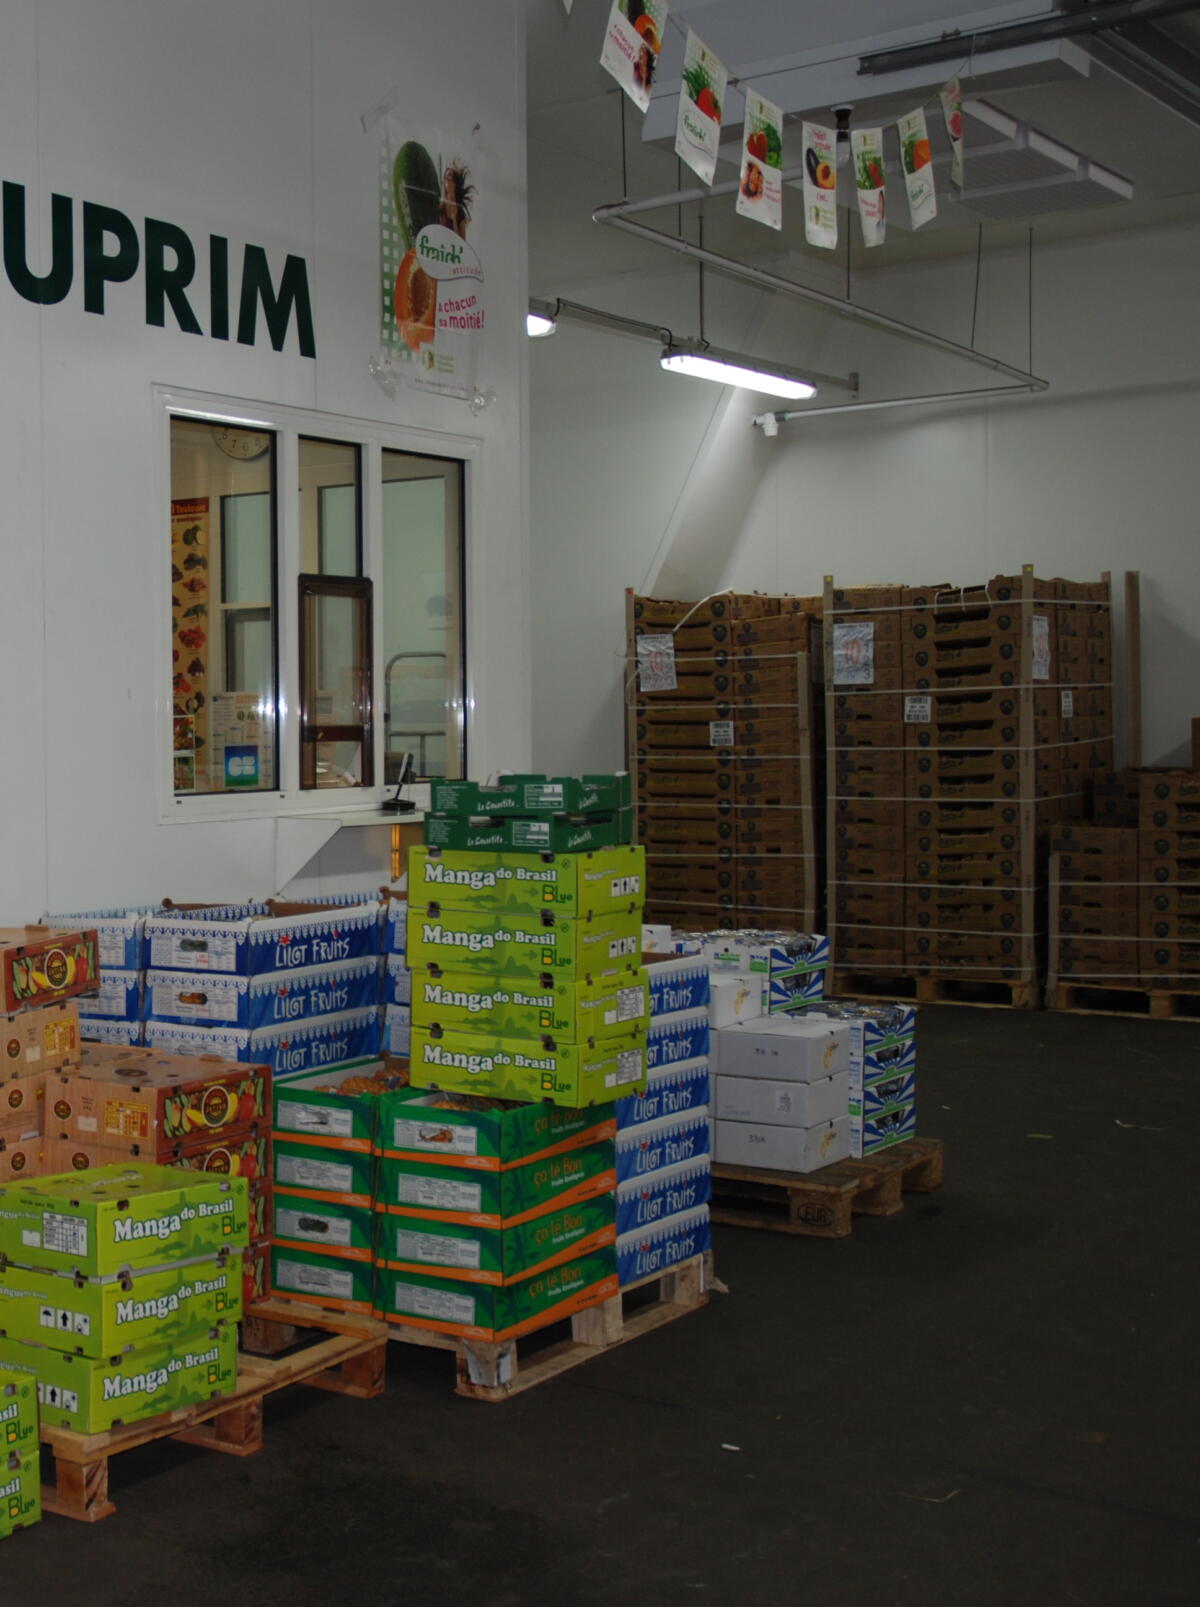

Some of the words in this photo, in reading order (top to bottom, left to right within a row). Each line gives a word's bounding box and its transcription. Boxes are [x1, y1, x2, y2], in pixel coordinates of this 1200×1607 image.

[453, 267, 481, 276] attitude
[444, 295, 476, 313] chacun
[424, 863, 496, 889] Manga
[496, 866, 512, 880] do
[516, 868, 557, 882] Brasil
[422, 925, 495, 950] Manga
[494, 929, 512, 942] do
[514, 931, 555, 946] Brasil
[424, 985, 494, 1012] Manga
[493, 991, 510, 1004] do
[512, 994, 553, 1008] Brasil
[423, 1045, 494, 1073] Manga
[494, 1053, 510, 1066] do
[514, 1056, 556, 1070] Brasil
[113, 1210, 181, 1243] Manga
[180, 1204, 196, 1222] do
[198, 1199, 234, 1217] Brasil
[115, 1293, 179, 1325] Manga
[178, 1283, 192, 1298] do
[194, 1276, 227, 1297] Brasil
[103, 1368, 168, 1400] Manga
[167, 1356, 182, 1374] do
[184, 1348, 219, 1368] Brasil
